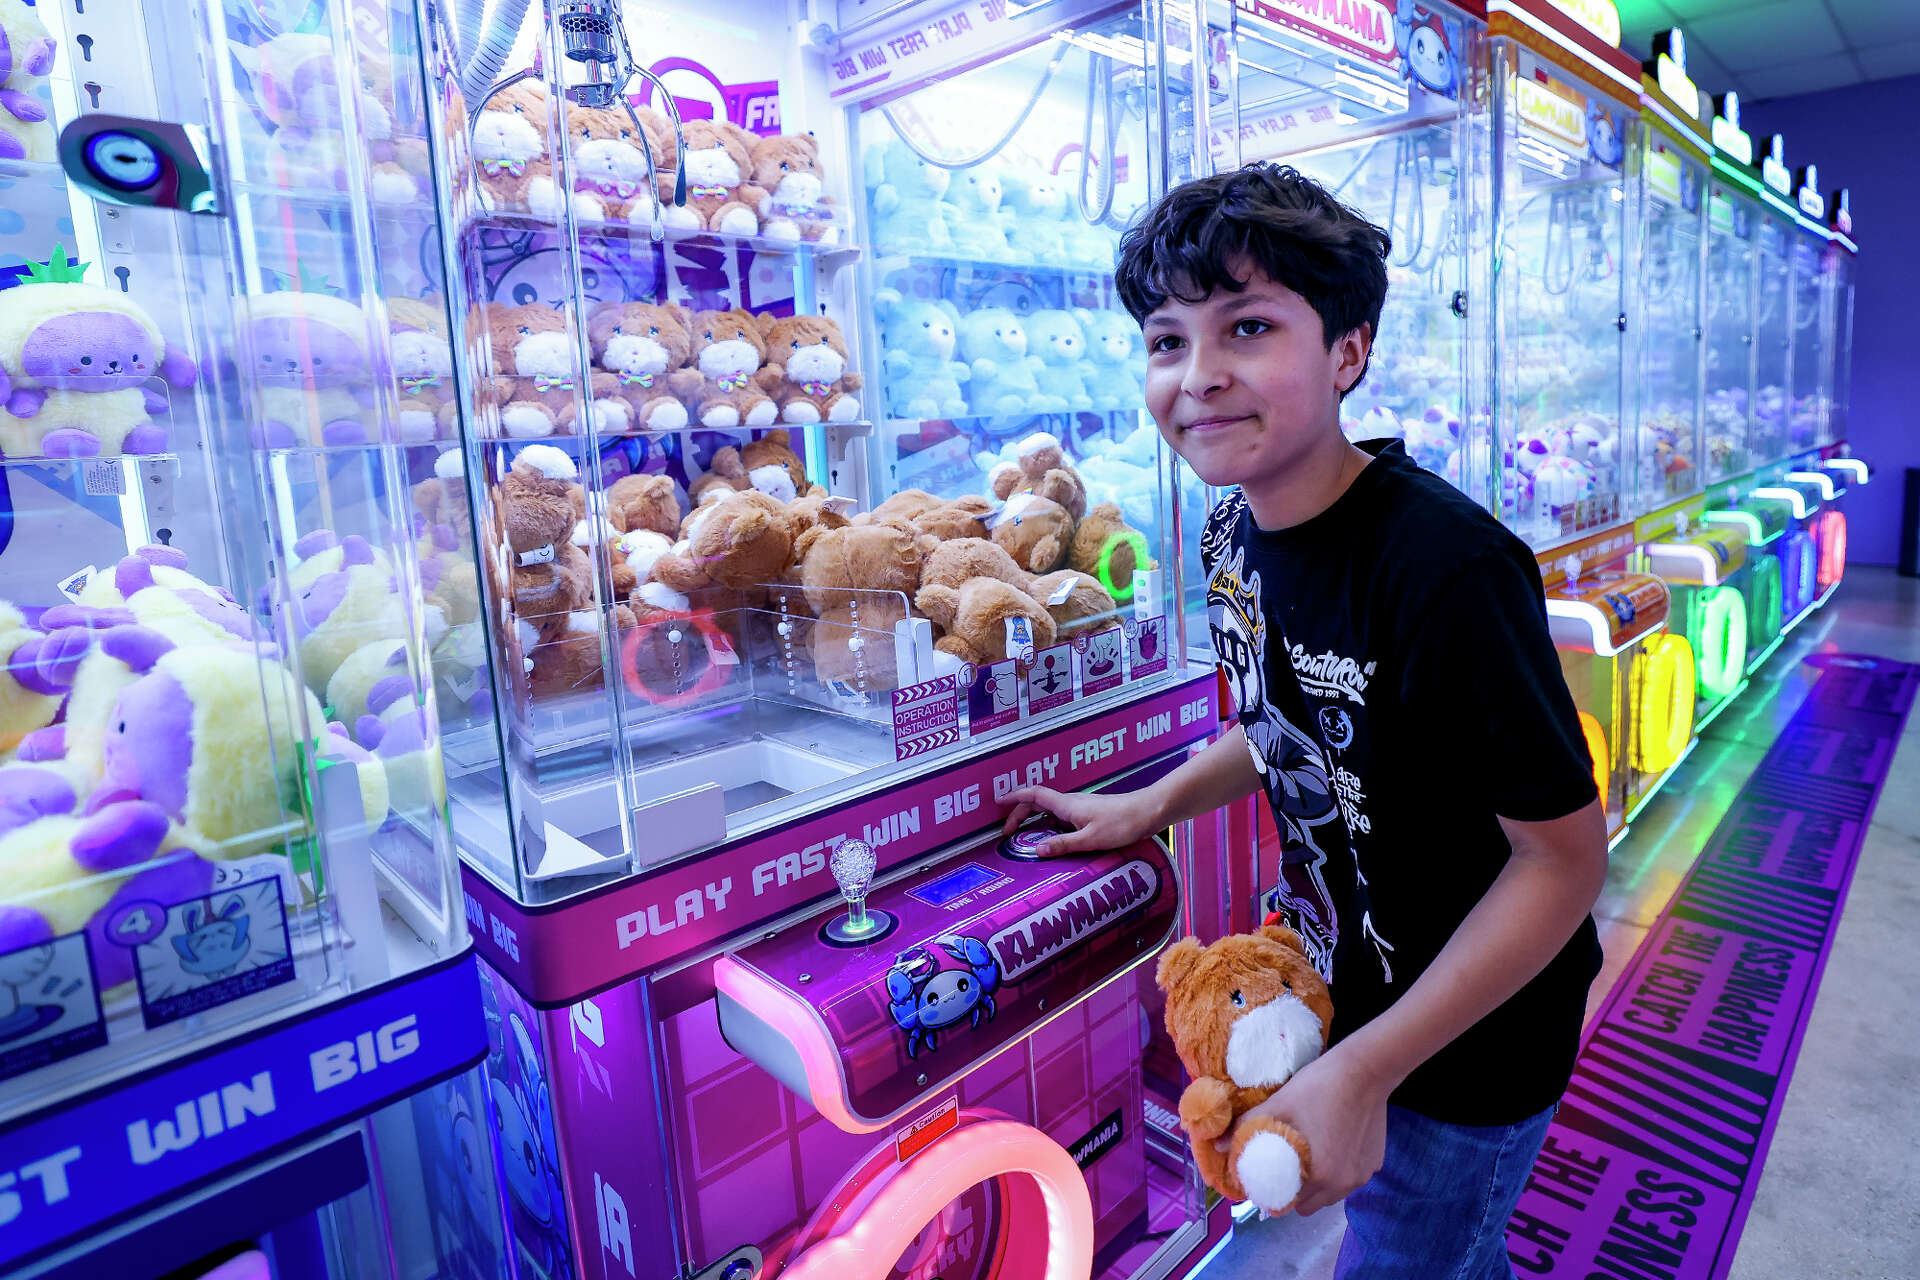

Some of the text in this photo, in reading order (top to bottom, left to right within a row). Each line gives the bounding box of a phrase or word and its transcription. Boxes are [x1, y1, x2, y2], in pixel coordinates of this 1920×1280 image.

[895, 699, 955, 725] OPERATION
[896, 710, 957, 738] INSTRUCTION
[615, 877, 732, 950] PLAY
[863, 806, 920, 849] WIN
[934, 784, 980, 824] BIG
[992, 753, 1060, 800] PLAY
[1070, 727, 1127, 770] FAST
[1136, 711, 1171, 743] WIN
[1180, 697, 1208, 727] BIG
[117, 908, 151, 937] 4
[490, 912, 520, 963] BIG
[944, 896, 973, 912] TIME
[980, 876, 1015, 896] ROUND
[994, 868, 1149, 975] KLAWMANIA
[1623, 925, 1724, 1033] CATCH THE
[1698, 942, 1795, 1062] HAPPINESS
[126, 1071, 276, 1165] WIN
[309, 1014, 420, 1093] BIG
[1584, 1170, 1705, 1280] INESS
